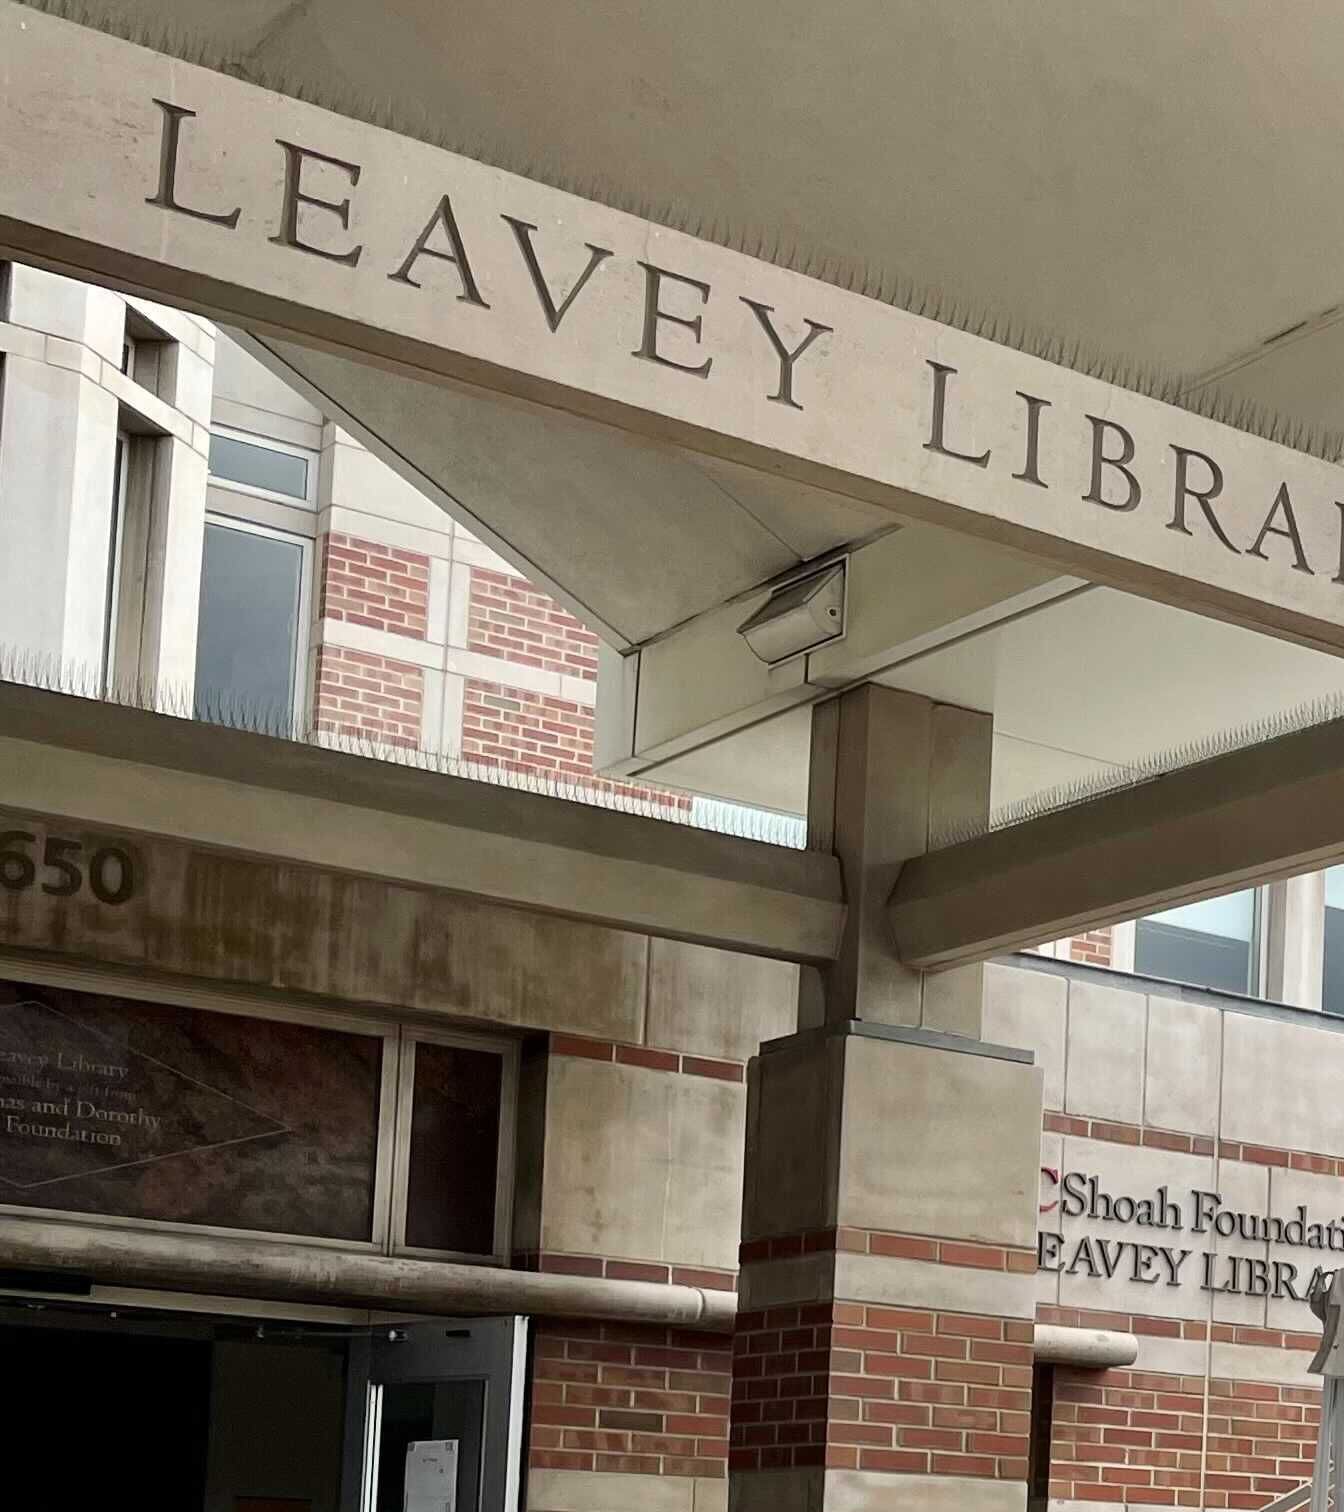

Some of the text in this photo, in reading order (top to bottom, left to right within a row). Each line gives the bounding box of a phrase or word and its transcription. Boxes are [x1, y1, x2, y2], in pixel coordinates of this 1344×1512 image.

[145, 98, 834, 411] LEAVEY
[0, 831, 134, 906] 650
[57, 1053, 129, 1080] Library
[7, 1115, 121, 1146] Foundation
[32, 1098, 69, 1117] and
[76, 1101, 161, 1133] Dorothy
[1063, 1172, 1183, 1230] Shoah
